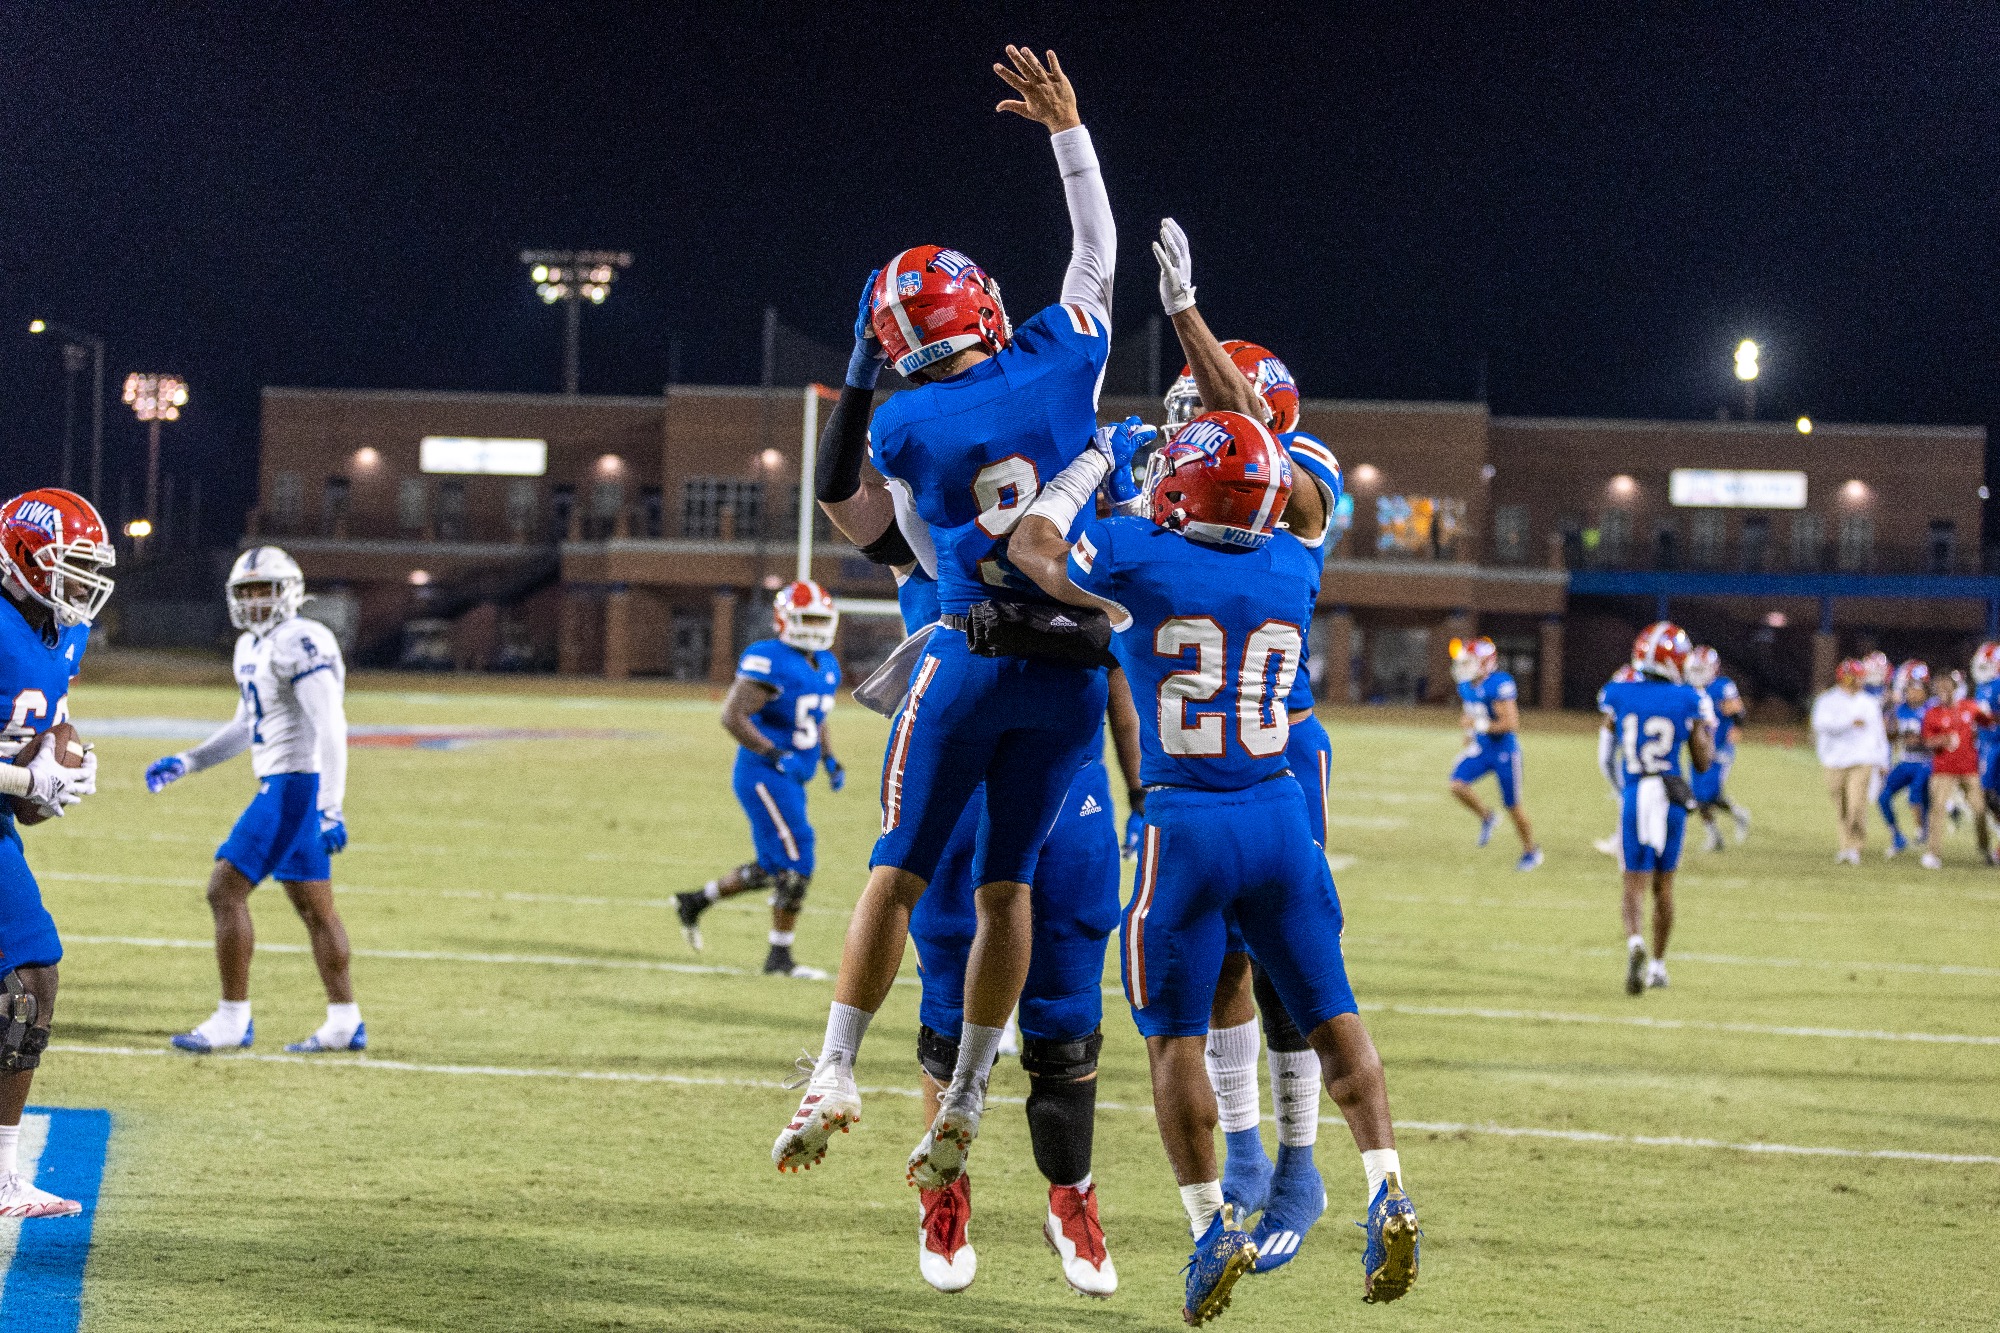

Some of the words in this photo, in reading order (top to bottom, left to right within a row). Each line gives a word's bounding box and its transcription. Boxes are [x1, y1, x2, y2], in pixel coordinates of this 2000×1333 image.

[900, 340, 954, 373] WOLVES
[1178, 421, 1229, 455] UWG
[15, 501, 56, 535] UWG
[1153, 615, 1301, 758] 20
[1622, 712, 1676, 774] 12
[1080, 805, 1102, 817] adidas
